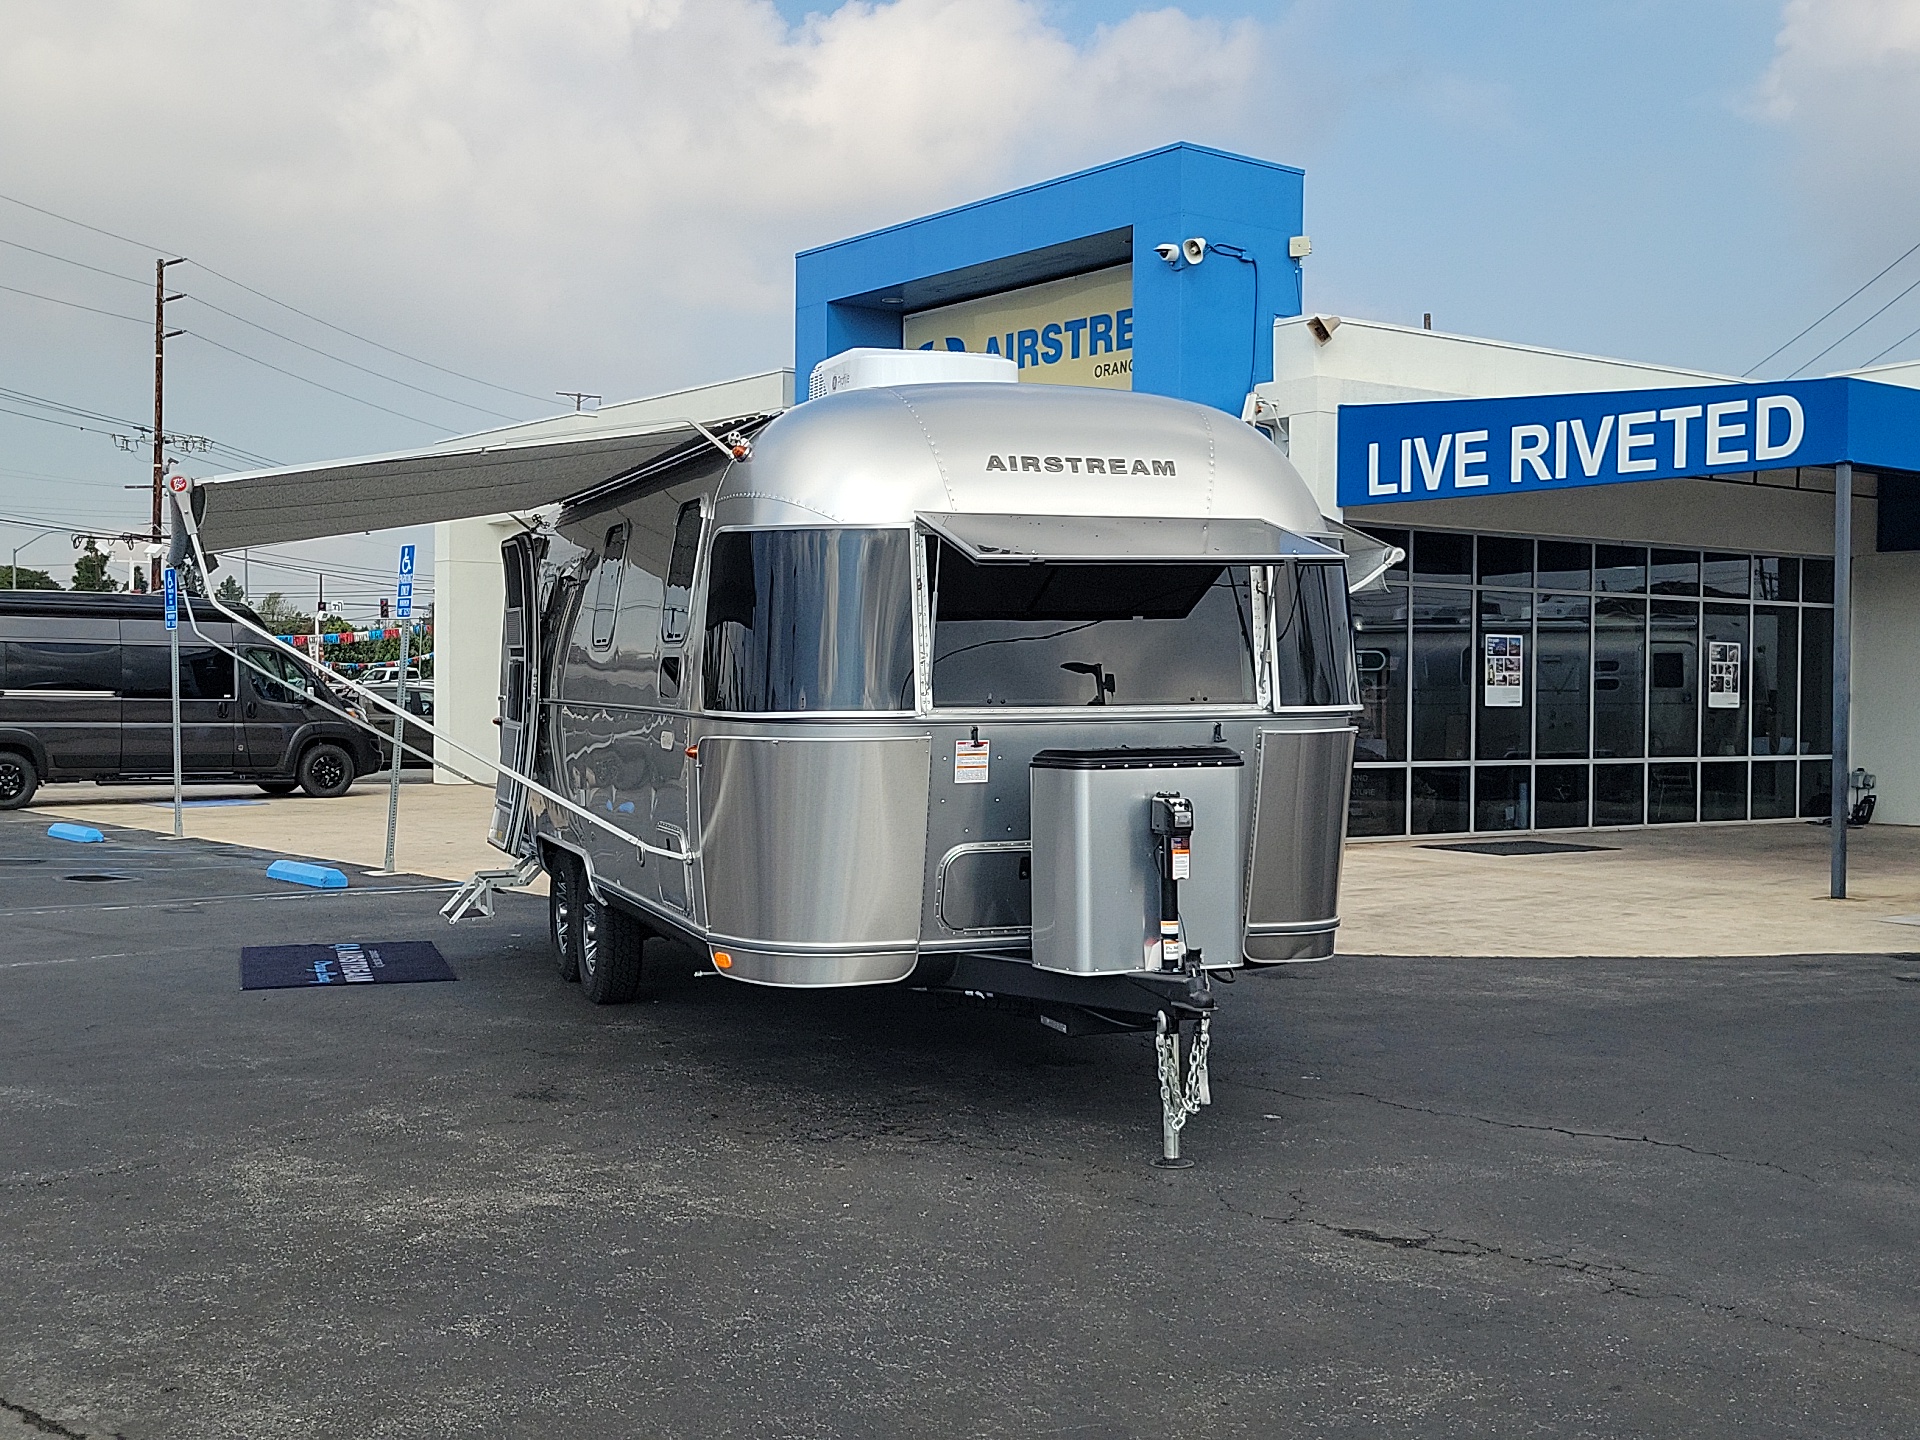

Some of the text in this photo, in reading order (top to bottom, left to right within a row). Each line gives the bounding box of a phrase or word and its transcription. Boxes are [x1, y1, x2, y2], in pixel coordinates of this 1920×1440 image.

[985, 454, 1177, 477] AIRSTREAM
[1368, 394, 1806, 496] LIVE RIVETED
